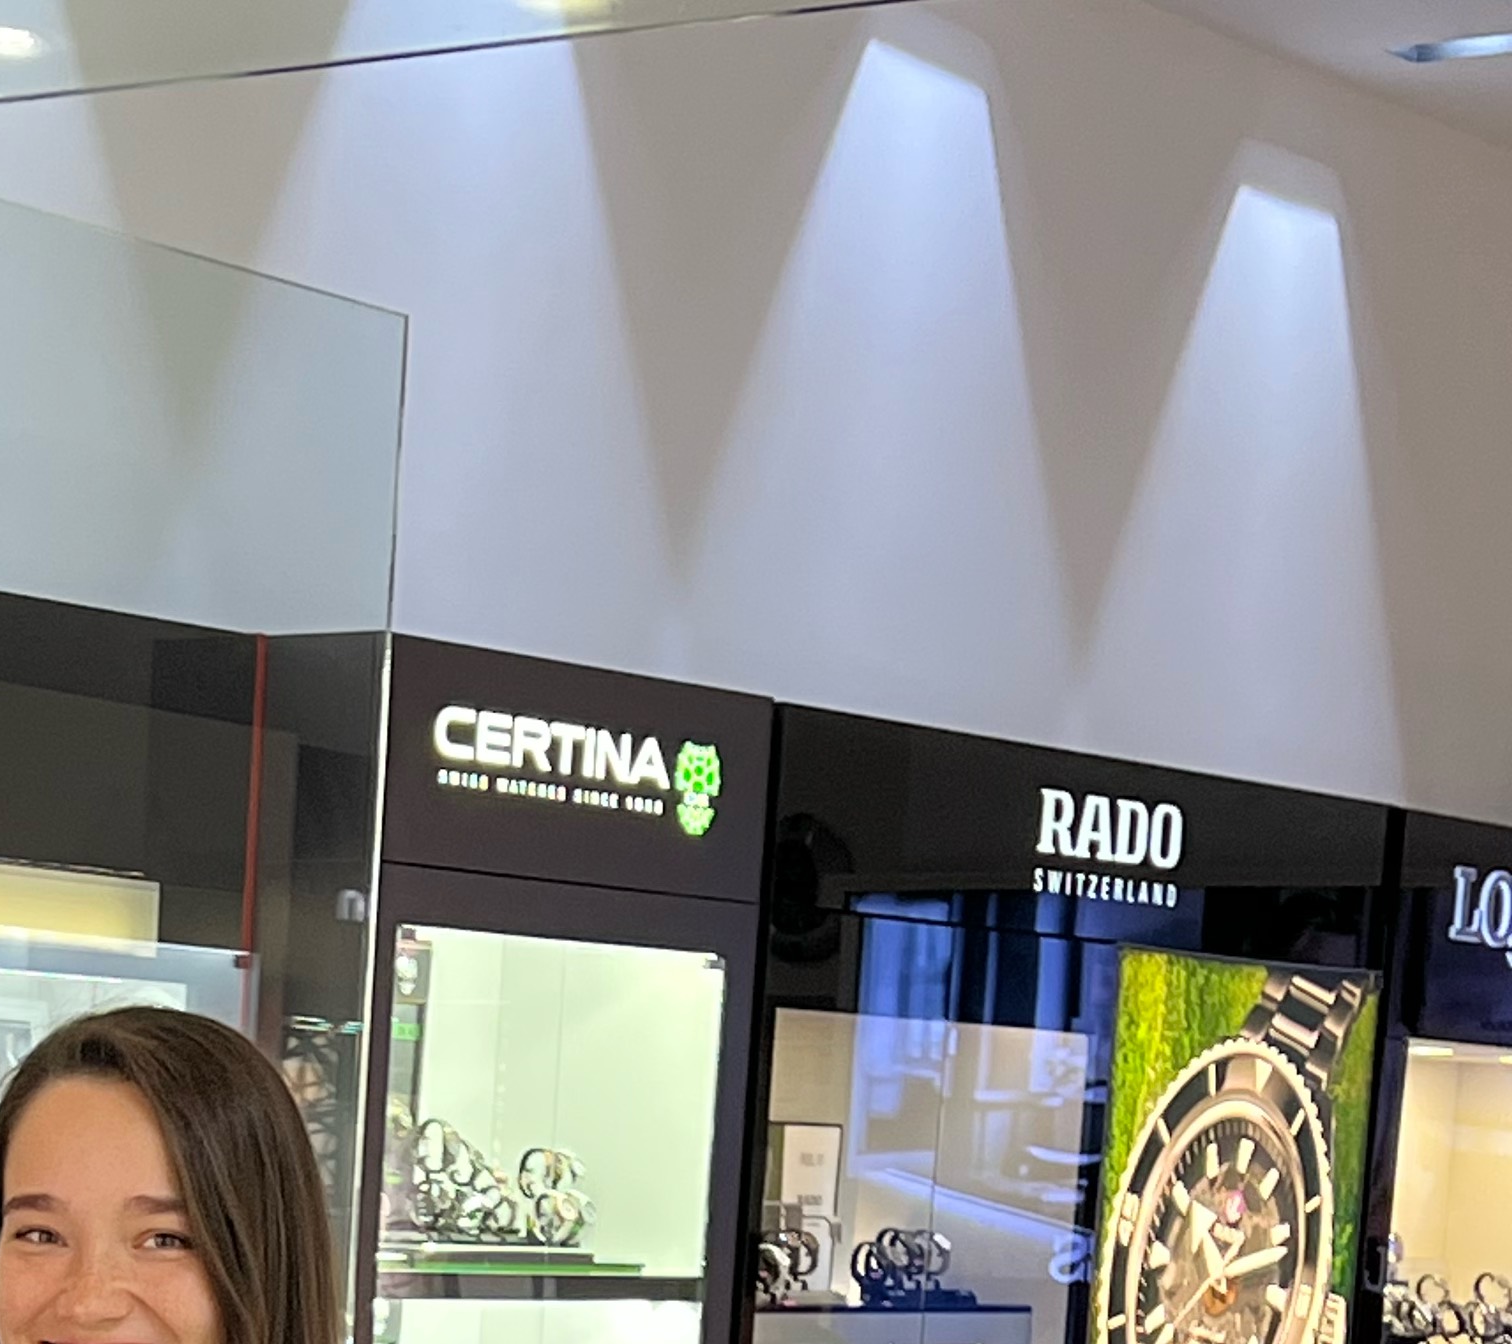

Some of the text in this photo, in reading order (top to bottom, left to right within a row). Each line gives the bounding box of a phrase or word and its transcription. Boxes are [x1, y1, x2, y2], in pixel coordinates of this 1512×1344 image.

[433, 704, 671, 790] CERTINA
[1036, 788, 1183, 870] RADO
[1033, 867, 1178, 909] SWITZERLAND
[1449, 865, 1512, 952] LO
